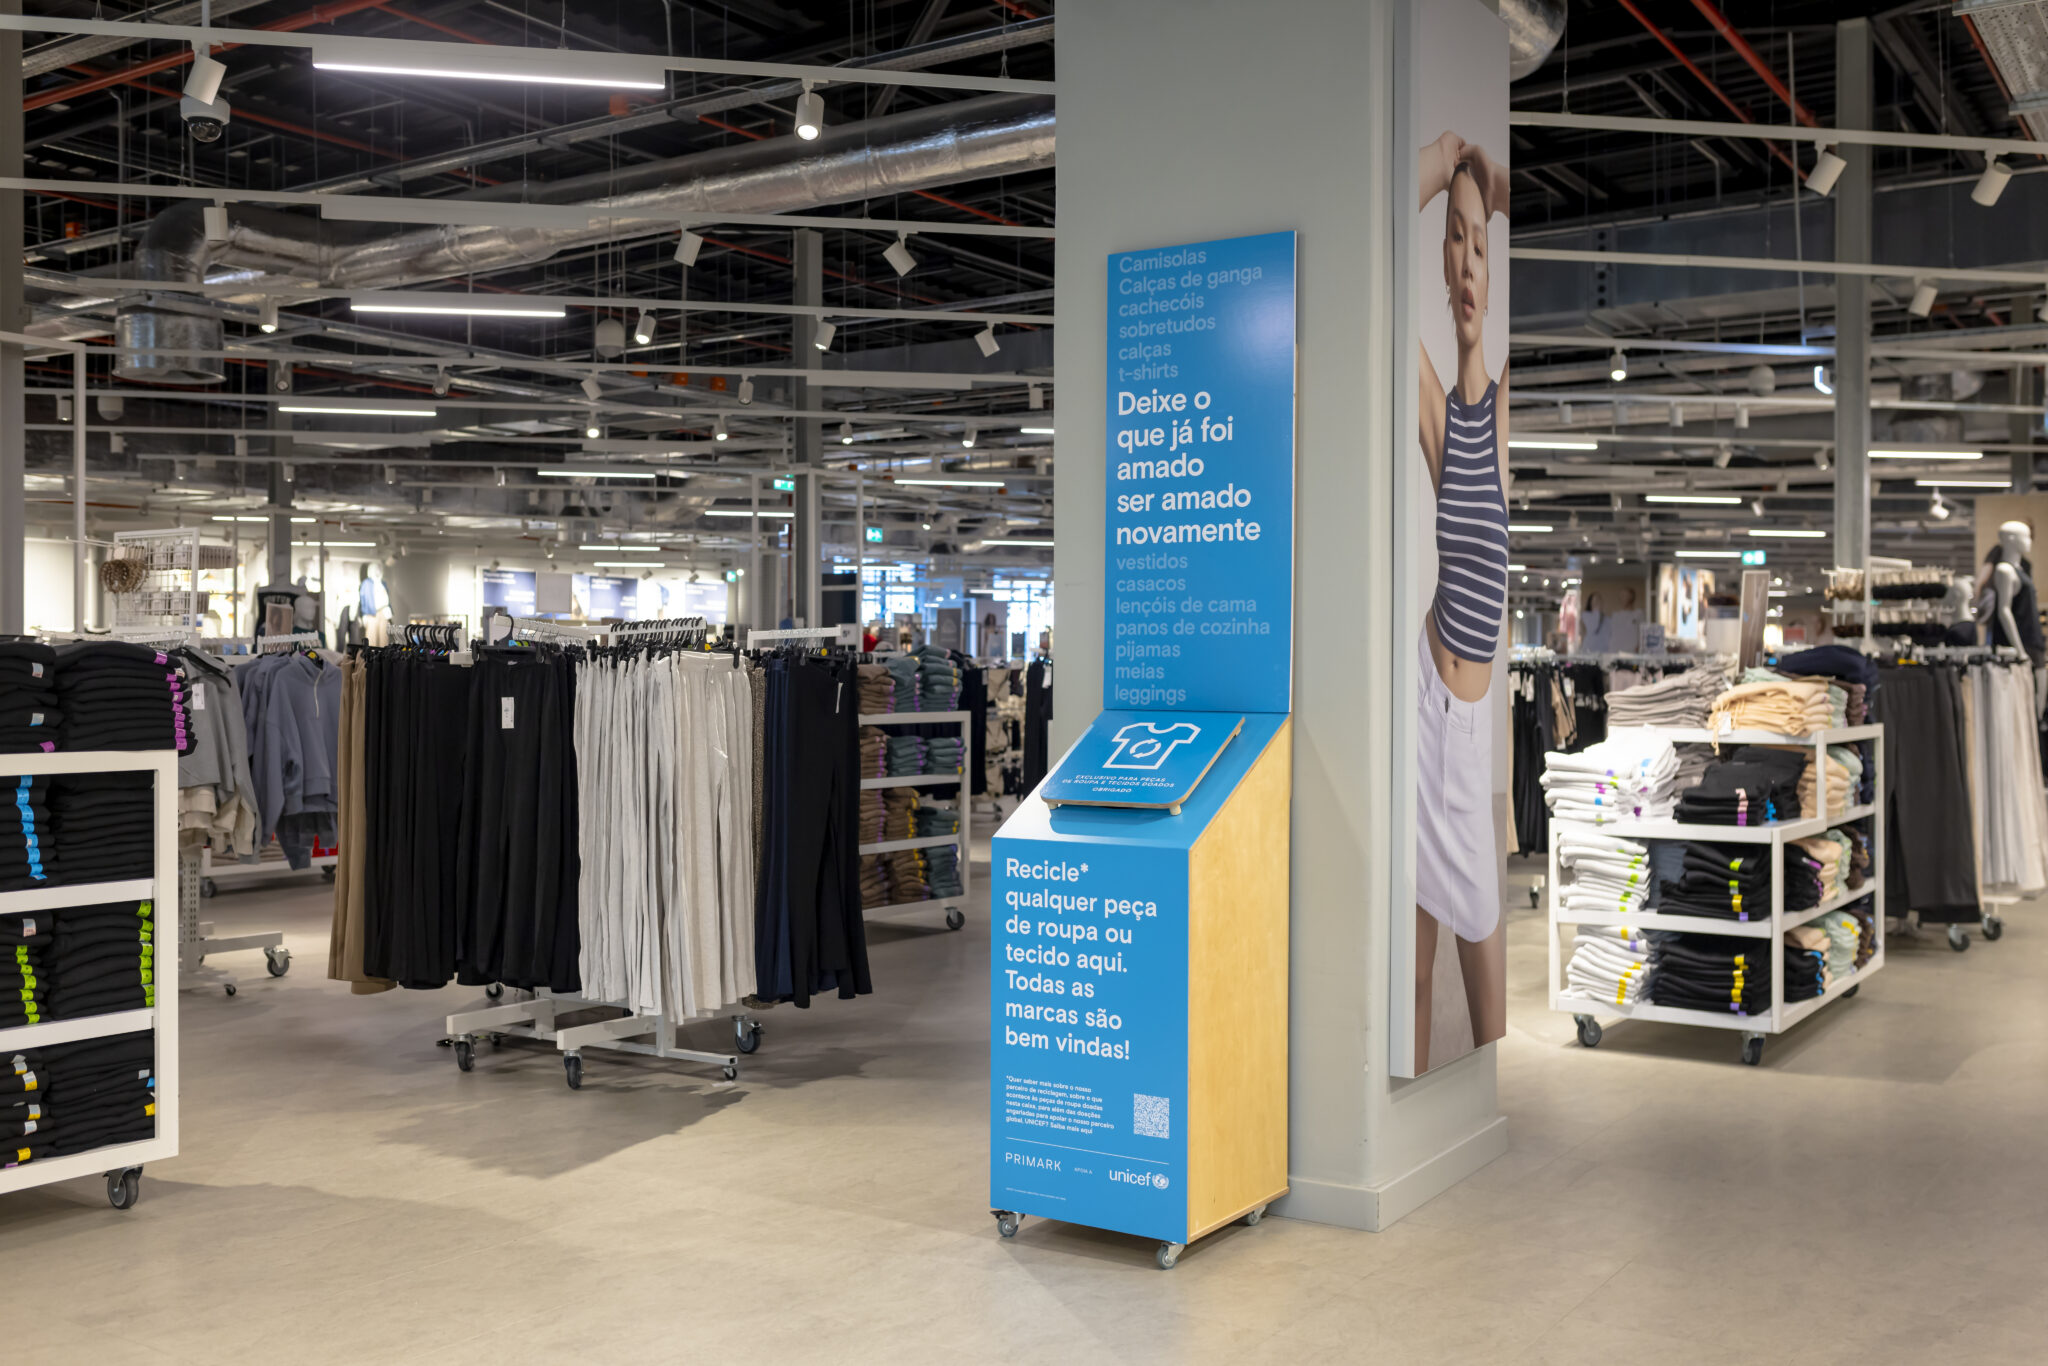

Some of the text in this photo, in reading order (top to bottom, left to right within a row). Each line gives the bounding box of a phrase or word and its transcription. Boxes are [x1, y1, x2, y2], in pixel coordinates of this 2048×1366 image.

[1120, 249, 1207, 273] Camisolas
[1119, 266, 1263, 295] Calças de ganga
[1119, 293, 1204, 317] cachecóis
[1120, 315, 1216, 338] sobretudos
[1119, 343, 1172, 362] calças
[1118, 362, 1178, 382] t-shirts
[1118, 388, 1211, 416] Deixe o
[1117, 416, 1233, 454] que já foi
[1117, 453, 1204, 480] amado
[1117, 483, 1251, 513] ser amado
[1116, 518, 1261, 545] novamente
[1117, 553, 1188, 570] vestidos
[1116, 578, 1186, 592] casacos
[1116, 596, 1256, 617] lençóis de cama
[1116, 618, 1270, 639] panos de cozinha
[1116, 641, 1180, 661] pijamas
[1115, 663, 1164, 679] meias
[1115, 684, 1186, 705] leggings
[1006, 888, 1157, 921] qualquer peça
[1006, 914, 1132, 944] de roupa ou
[1006, 944, 1127, 975] tecido aqui.
[1005, 970, 1094, 998] Todas as
[1006, 1002, 1122, 1030] marcas são
[1006, 1026, 1130, 1060] bem vindas!
[1091, 1121, 1114, 1129] parceiro
[1005, 1152, 1062, 1172] PRIMARK
[1109, 1169, 1151, 1186] unicef
